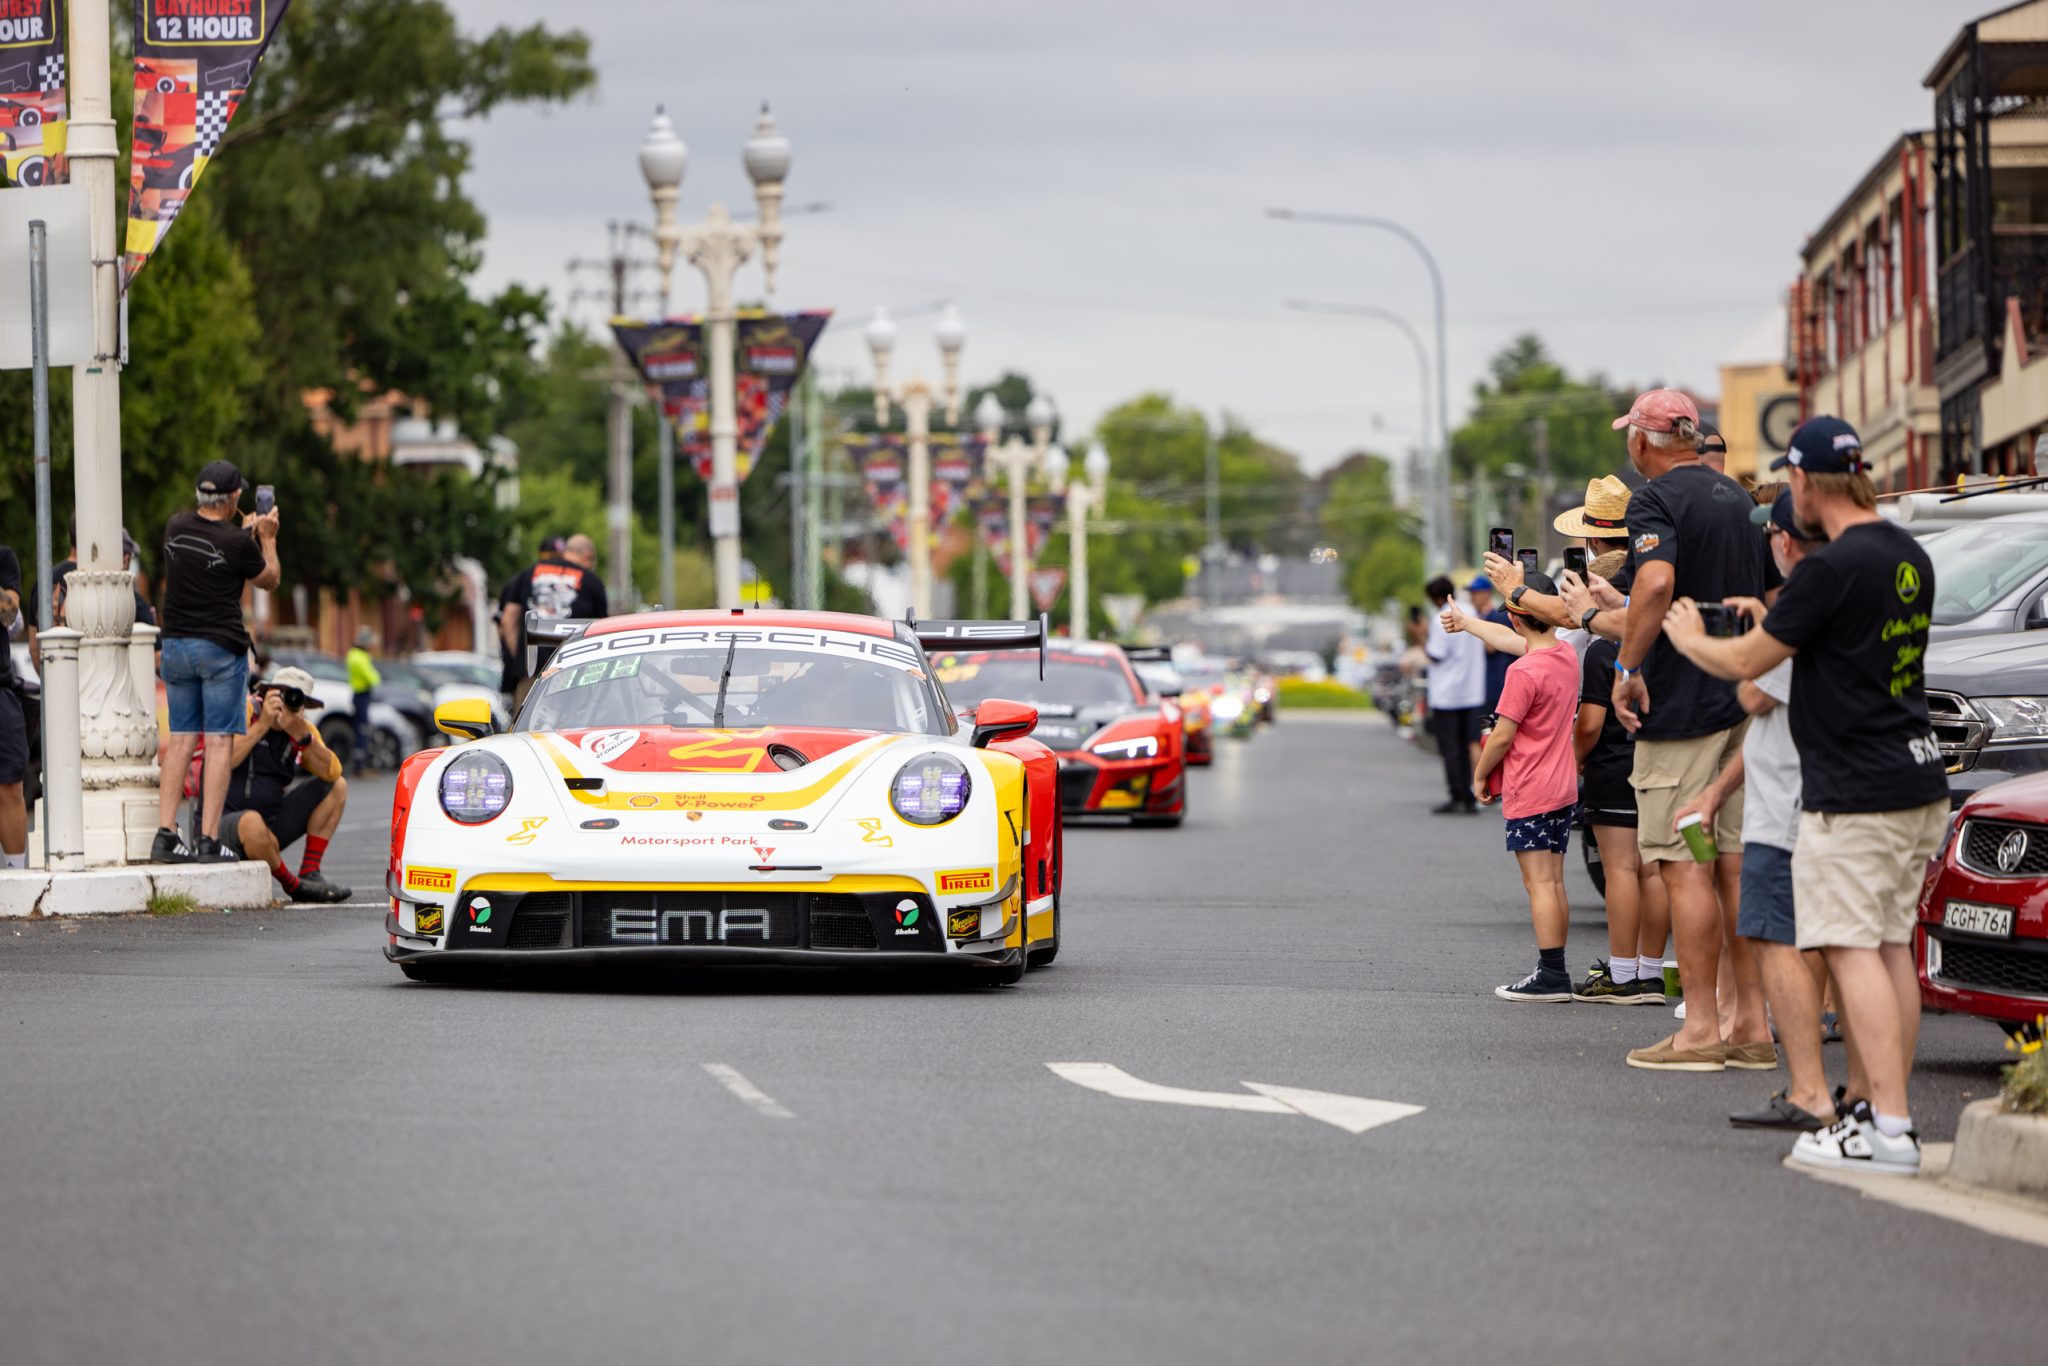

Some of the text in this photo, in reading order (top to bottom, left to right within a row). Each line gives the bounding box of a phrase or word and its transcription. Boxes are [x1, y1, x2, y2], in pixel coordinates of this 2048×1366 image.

[155, 0, 250, 16] BATHURST
[156, 17, 253, 39] 12 HOUR
[556, 631, 919, 668] PORSCHE
[675, 800, 758, 809] V-Power
[621, 836, 758, 847] Motorsport Park
[408, 870, 452, 888] PIRELLI
[941, 872, 990, 890] PIRELLI
[611, 908, 770, 941] EMA
[895, 928, 919, 936] Shahin
